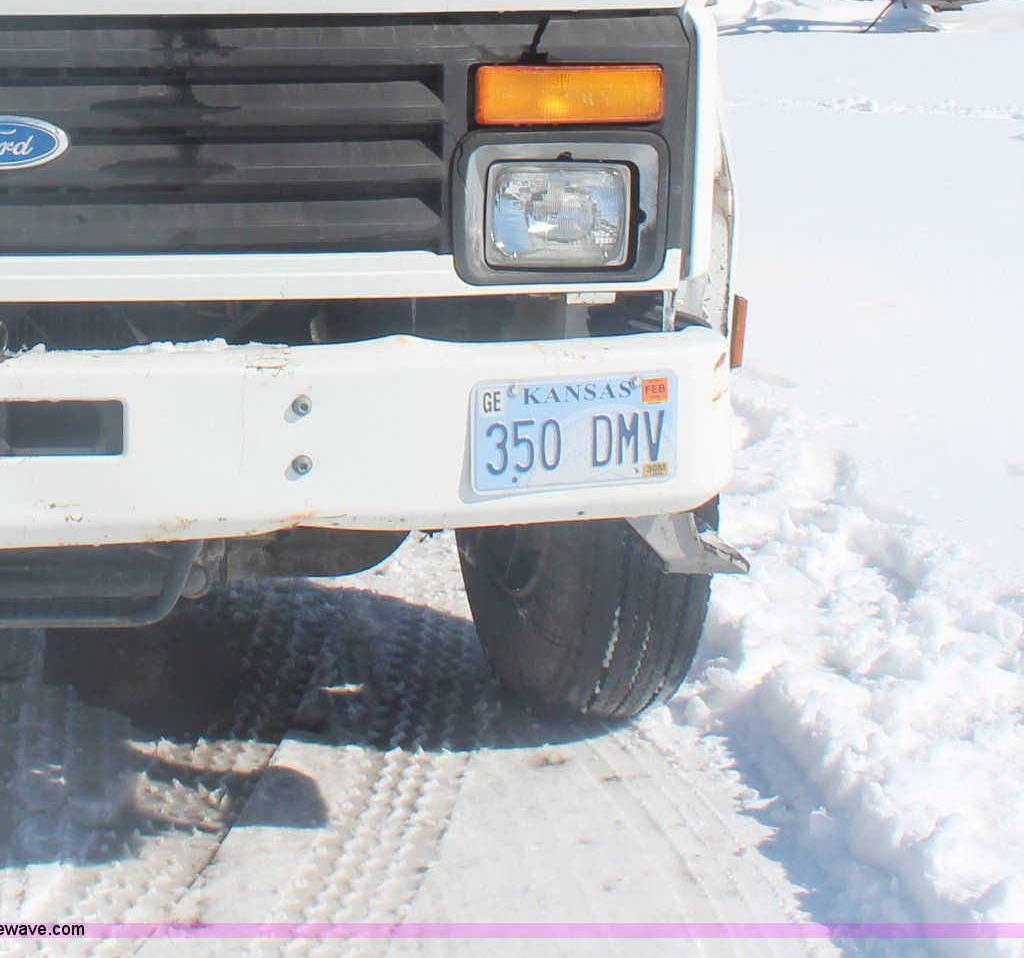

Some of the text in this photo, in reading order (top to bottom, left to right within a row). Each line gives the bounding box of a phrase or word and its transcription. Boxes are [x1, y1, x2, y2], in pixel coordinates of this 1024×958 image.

[523, 380, 632, 405] KANSAS
[645, 384, 666, 395] FEB
[482, 391, 501, 413] GE
[486, 409, 665, 475] 350 DMV
